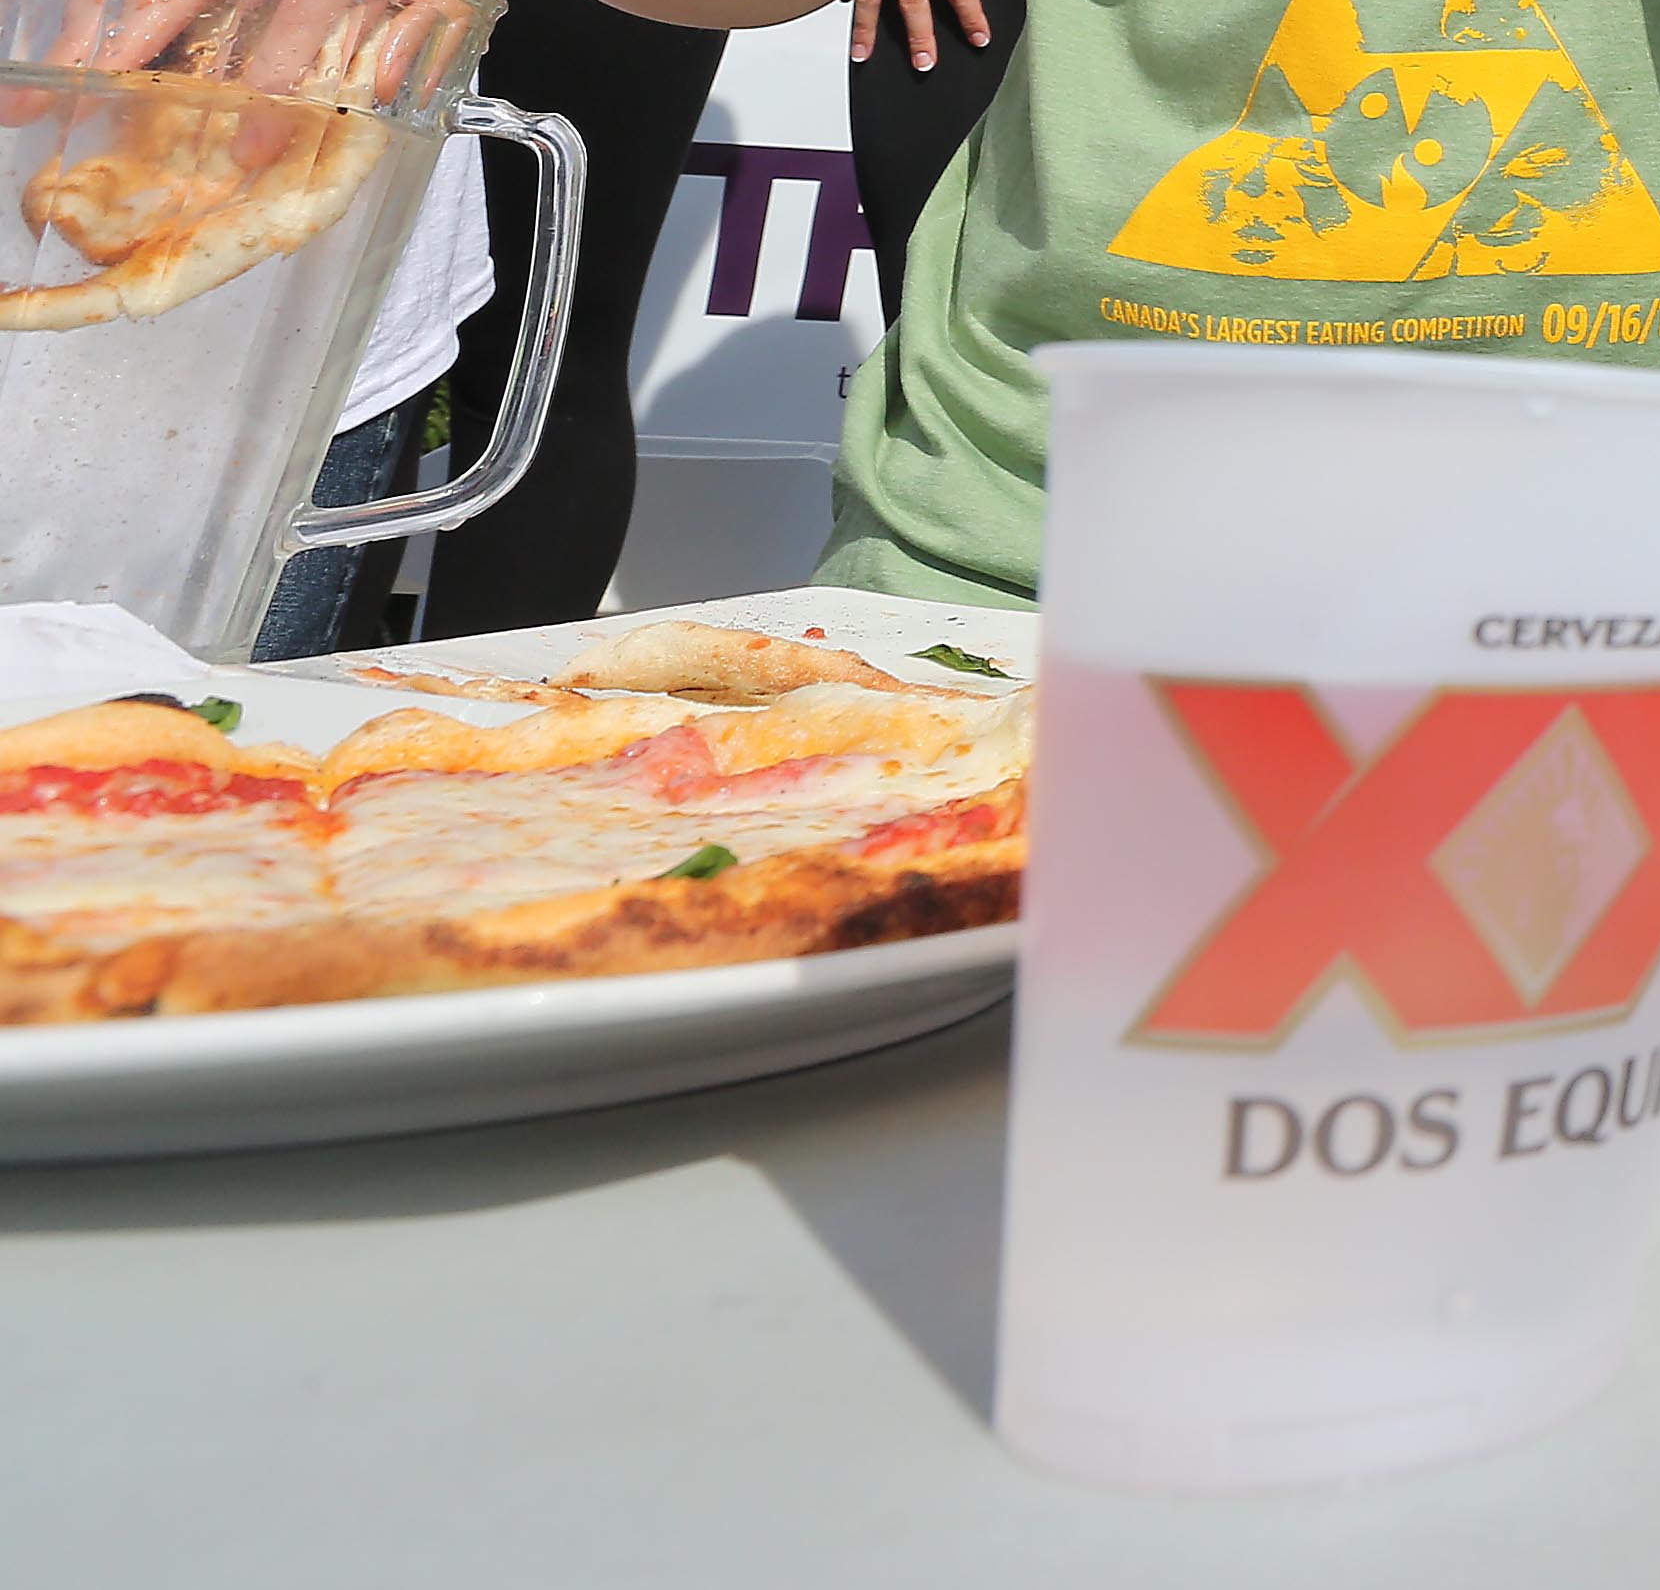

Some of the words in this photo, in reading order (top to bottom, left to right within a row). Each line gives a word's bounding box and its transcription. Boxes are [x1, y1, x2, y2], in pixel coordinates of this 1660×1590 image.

[1100, 296, 1200, 339] CANADA'S
[1205, 314, 1301, 345] LARGEST
[1306, 320, 1386, 345] EATING
[1221, 1090, 1462, 1182] DOS
